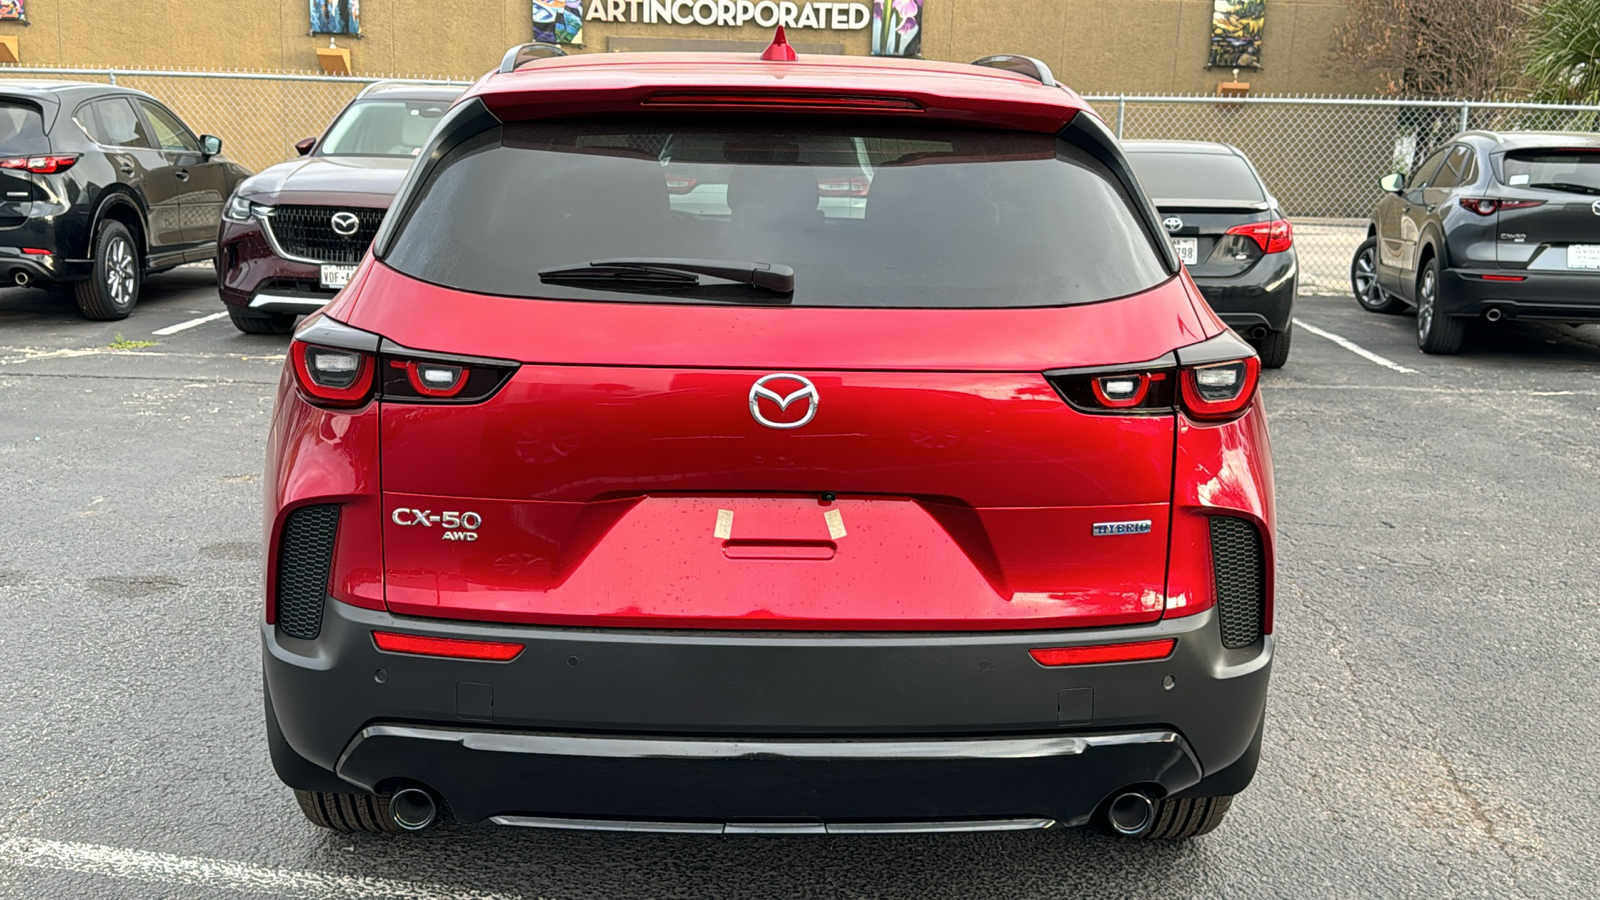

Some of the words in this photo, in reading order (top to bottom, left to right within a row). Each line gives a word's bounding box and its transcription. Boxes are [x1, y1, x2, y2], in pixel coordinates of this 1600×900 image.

[1175, 246, 1193, 260] 798
[391, 507, 482, 530] CX-50
[1095, 521, 1151, 534] HYBRID
[442, 531, 478, 541] AWD
